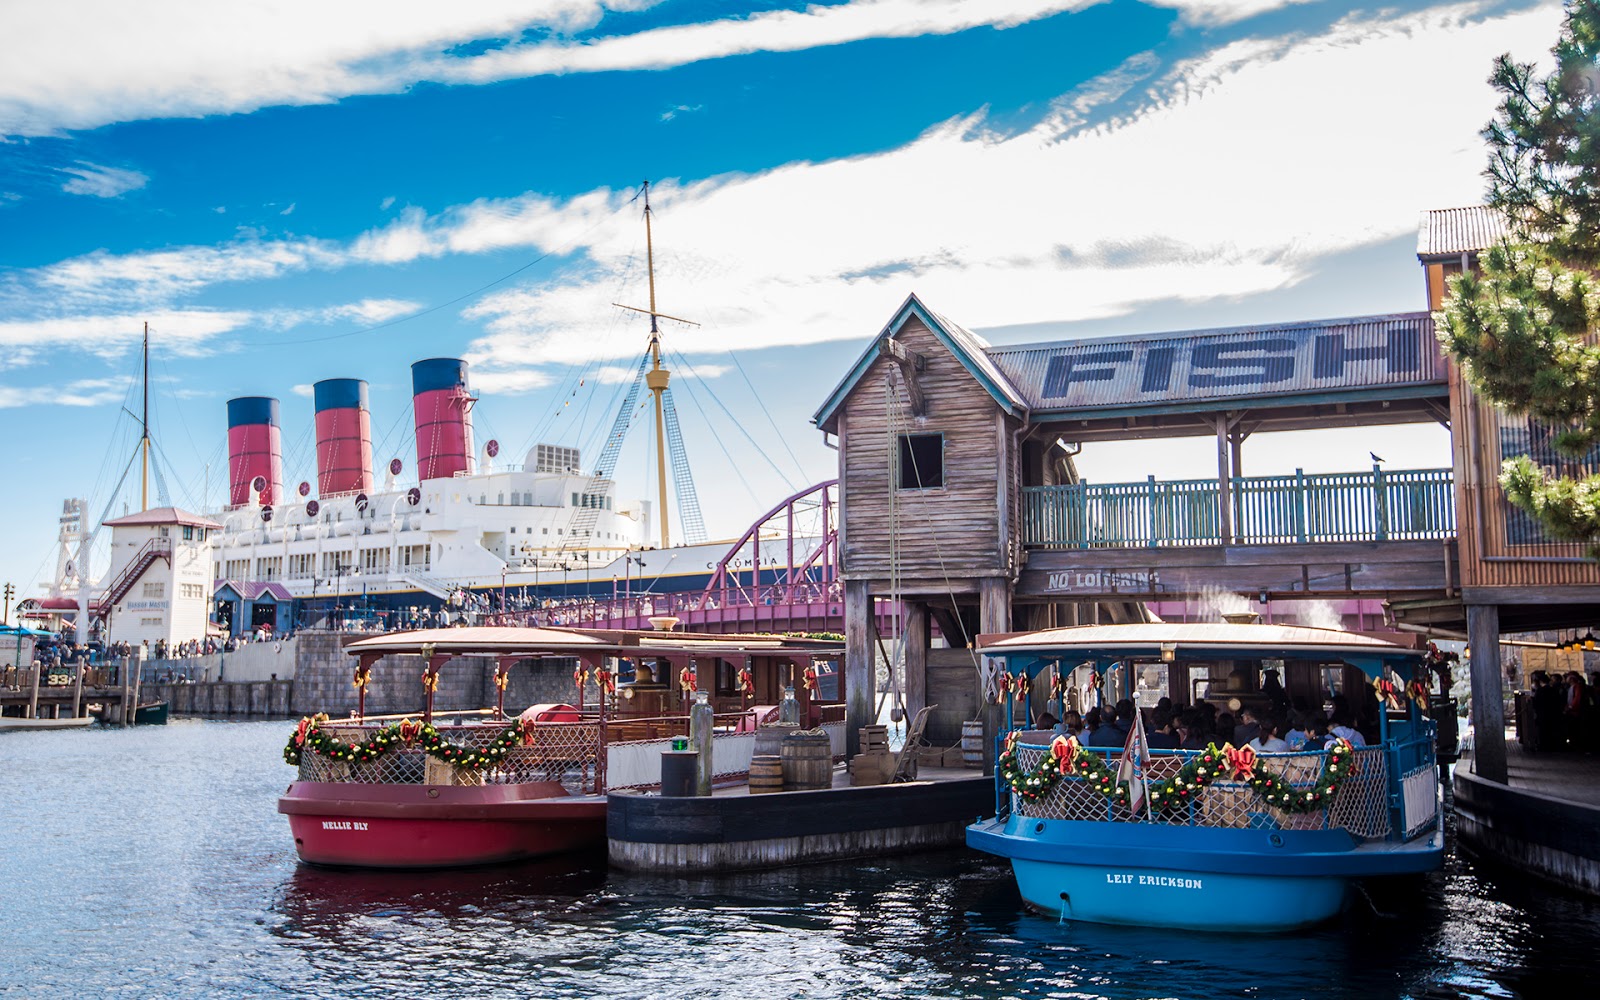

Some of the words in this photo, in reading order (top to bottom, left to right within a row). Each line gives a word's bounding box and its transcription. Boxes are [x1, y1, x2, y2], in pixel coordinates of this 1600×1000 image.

[1041, 328, 1421, 399] FISH
[706, 557, 777, 570] COUMIA
[1048, 573, 1070, 589] NO
[1076, 572, 1160, 588] LOITERING
[48, 674, 69, 686] 33
[322, 821, 352, 830] NELLIE
[353, 822, 369, 831] BLY
[1106, 874, 1134, 884] LEIF
[1139, 875, 1203, 889] ERICKSON
